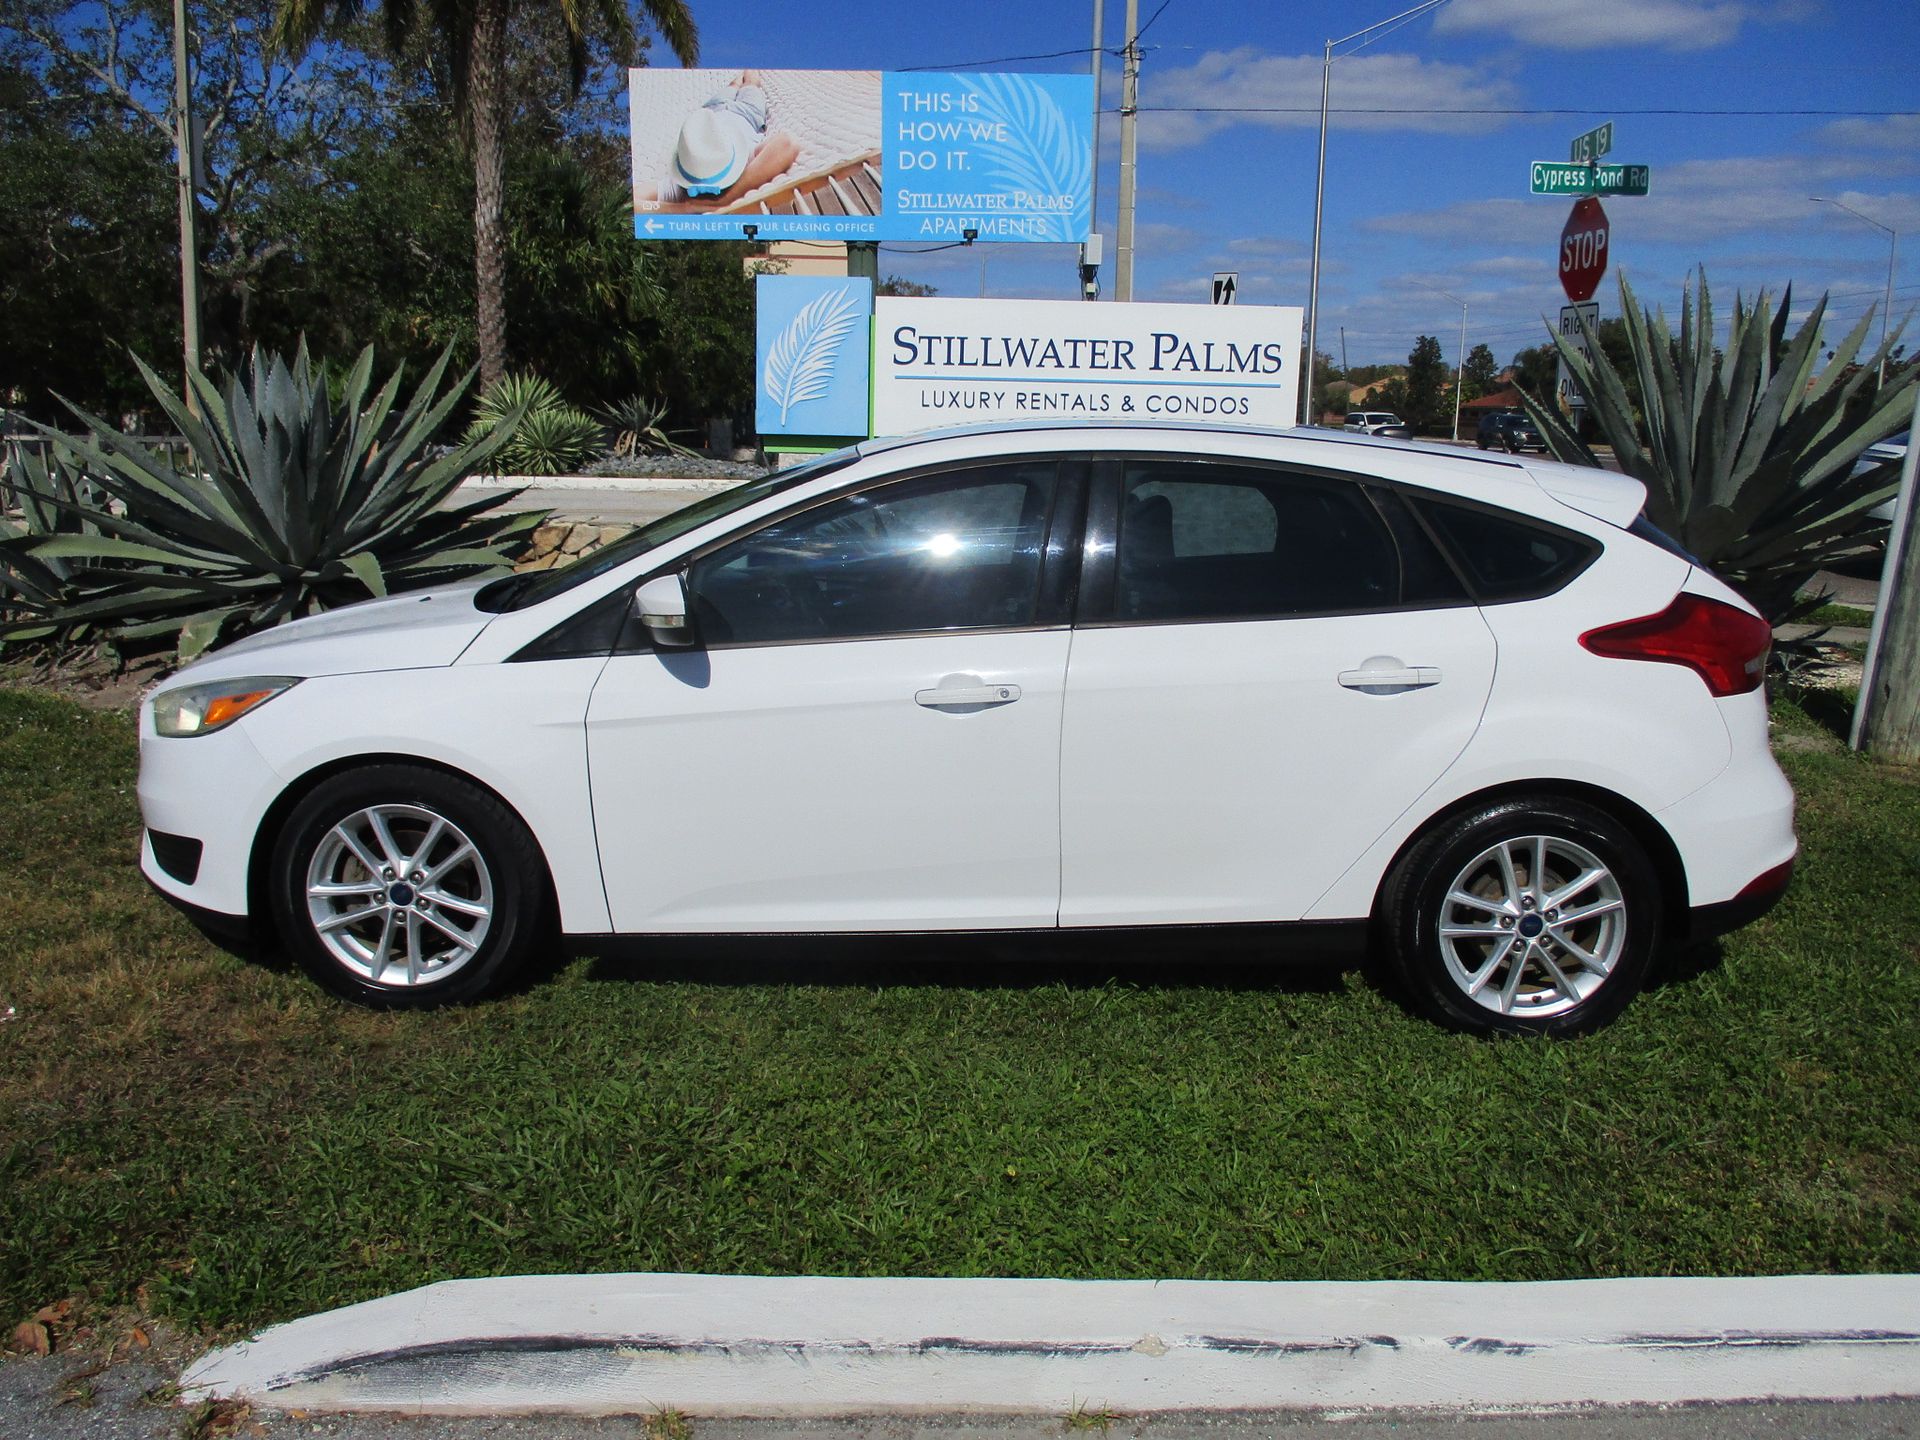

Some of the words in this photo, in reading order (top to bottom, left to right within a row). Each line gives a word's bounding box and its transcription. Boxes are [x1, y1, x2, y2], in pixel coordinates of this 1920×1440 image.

[898, 93, 951, 113] THIS
[961, 93, 979, 113] IS
[899, 122, 963, 142] HOW
[968, 123, 1008, 142] WE
[1573, 136, 1590, 162] US
[1596, 127, 1608, 157] 19
[899, 151, 937, 171] DO
[947, 151, 972, 171] IT.
[1533, 165, 1586, 191] Cypress
[1592, 167, 1624, 187] Pond
[1630, 168, 1648, 187] Rd
[897, 190, 1007, 209] STILLWATER
[1011, 191, 1074, 210] PALMS
[669, 221, 700, 232] TURN
[705, 221, 730, 232] LEFT
[756, 222, 779, 232] OUR
[783, 222, 831, 233] LEASING
[835, 222, 875, 233] OFFICE
[920, 217, 1047, 235] APARTMENTS
[1562, 229, 1606, 273] STOP
[893, 326, 1136, 369] STILLWATER
[1149, 333, 1283, 375] PALMS
[920, 390, 1006, 410] LUXURY
[1015, 392, 1111, 413] RENTALS
[1122, 396, 1136, 413] &
[1145, 395, 1250, 416] CONDOS
